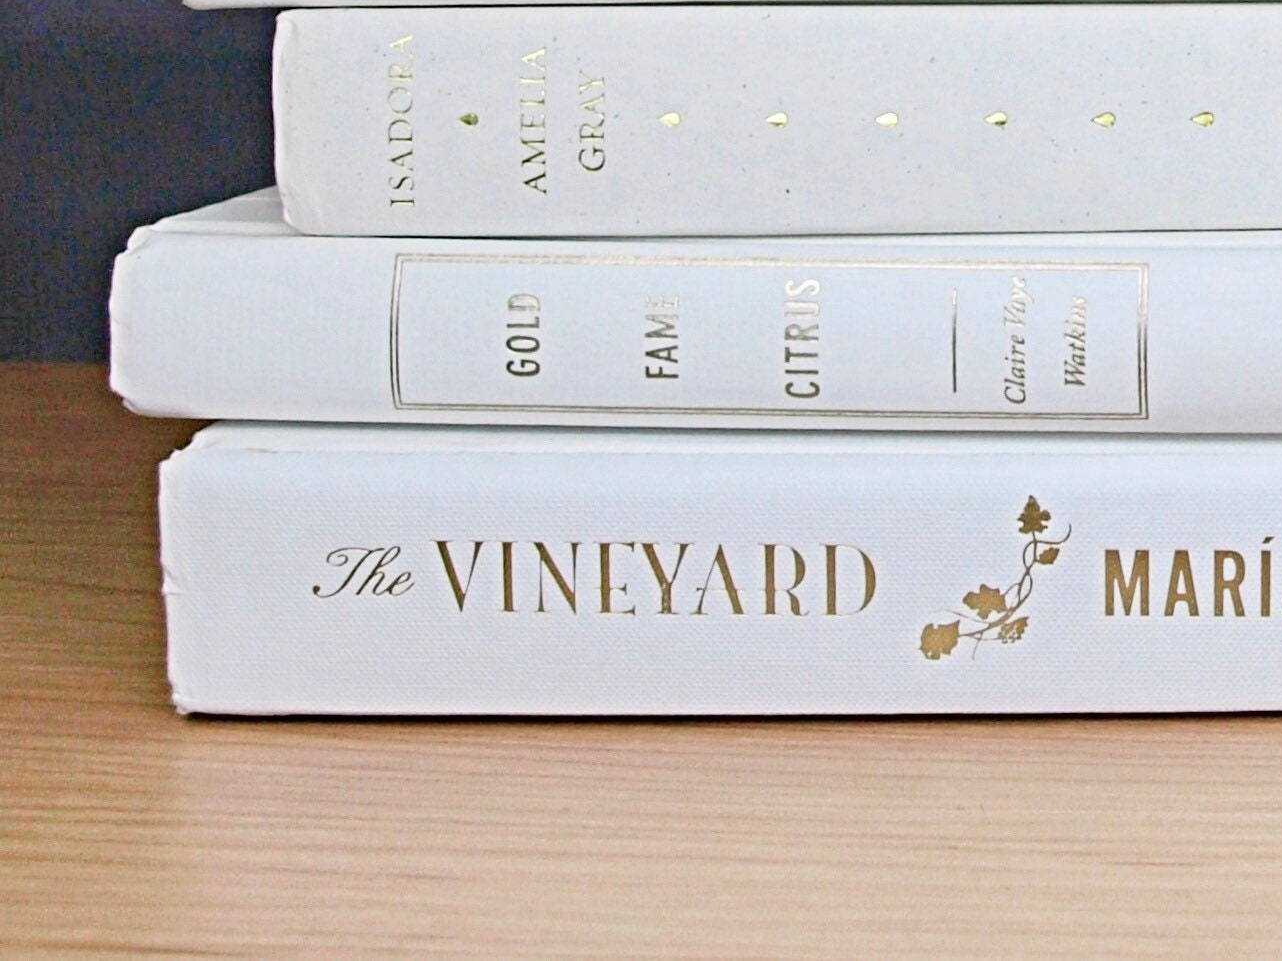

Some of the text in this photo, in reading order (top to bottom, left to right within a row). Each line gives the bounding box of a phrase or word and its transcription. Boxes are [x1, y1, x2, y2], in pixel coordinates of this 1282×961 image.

[387, 34, 415, 207] ISADORA
[520, 45, 547, 195] AMELIA
[578, 69, 606, 172] GRAY
[506, 293, 541, 377] GOLD
[645, 294, 680, 379] FAME
[784, 279, 820, 399] CITRUS
[1003, 334, 1027, 405] Claire
[1064, 295, 1088, 388] Watkins
[312, 538, 877, 618] The VINEYARD
